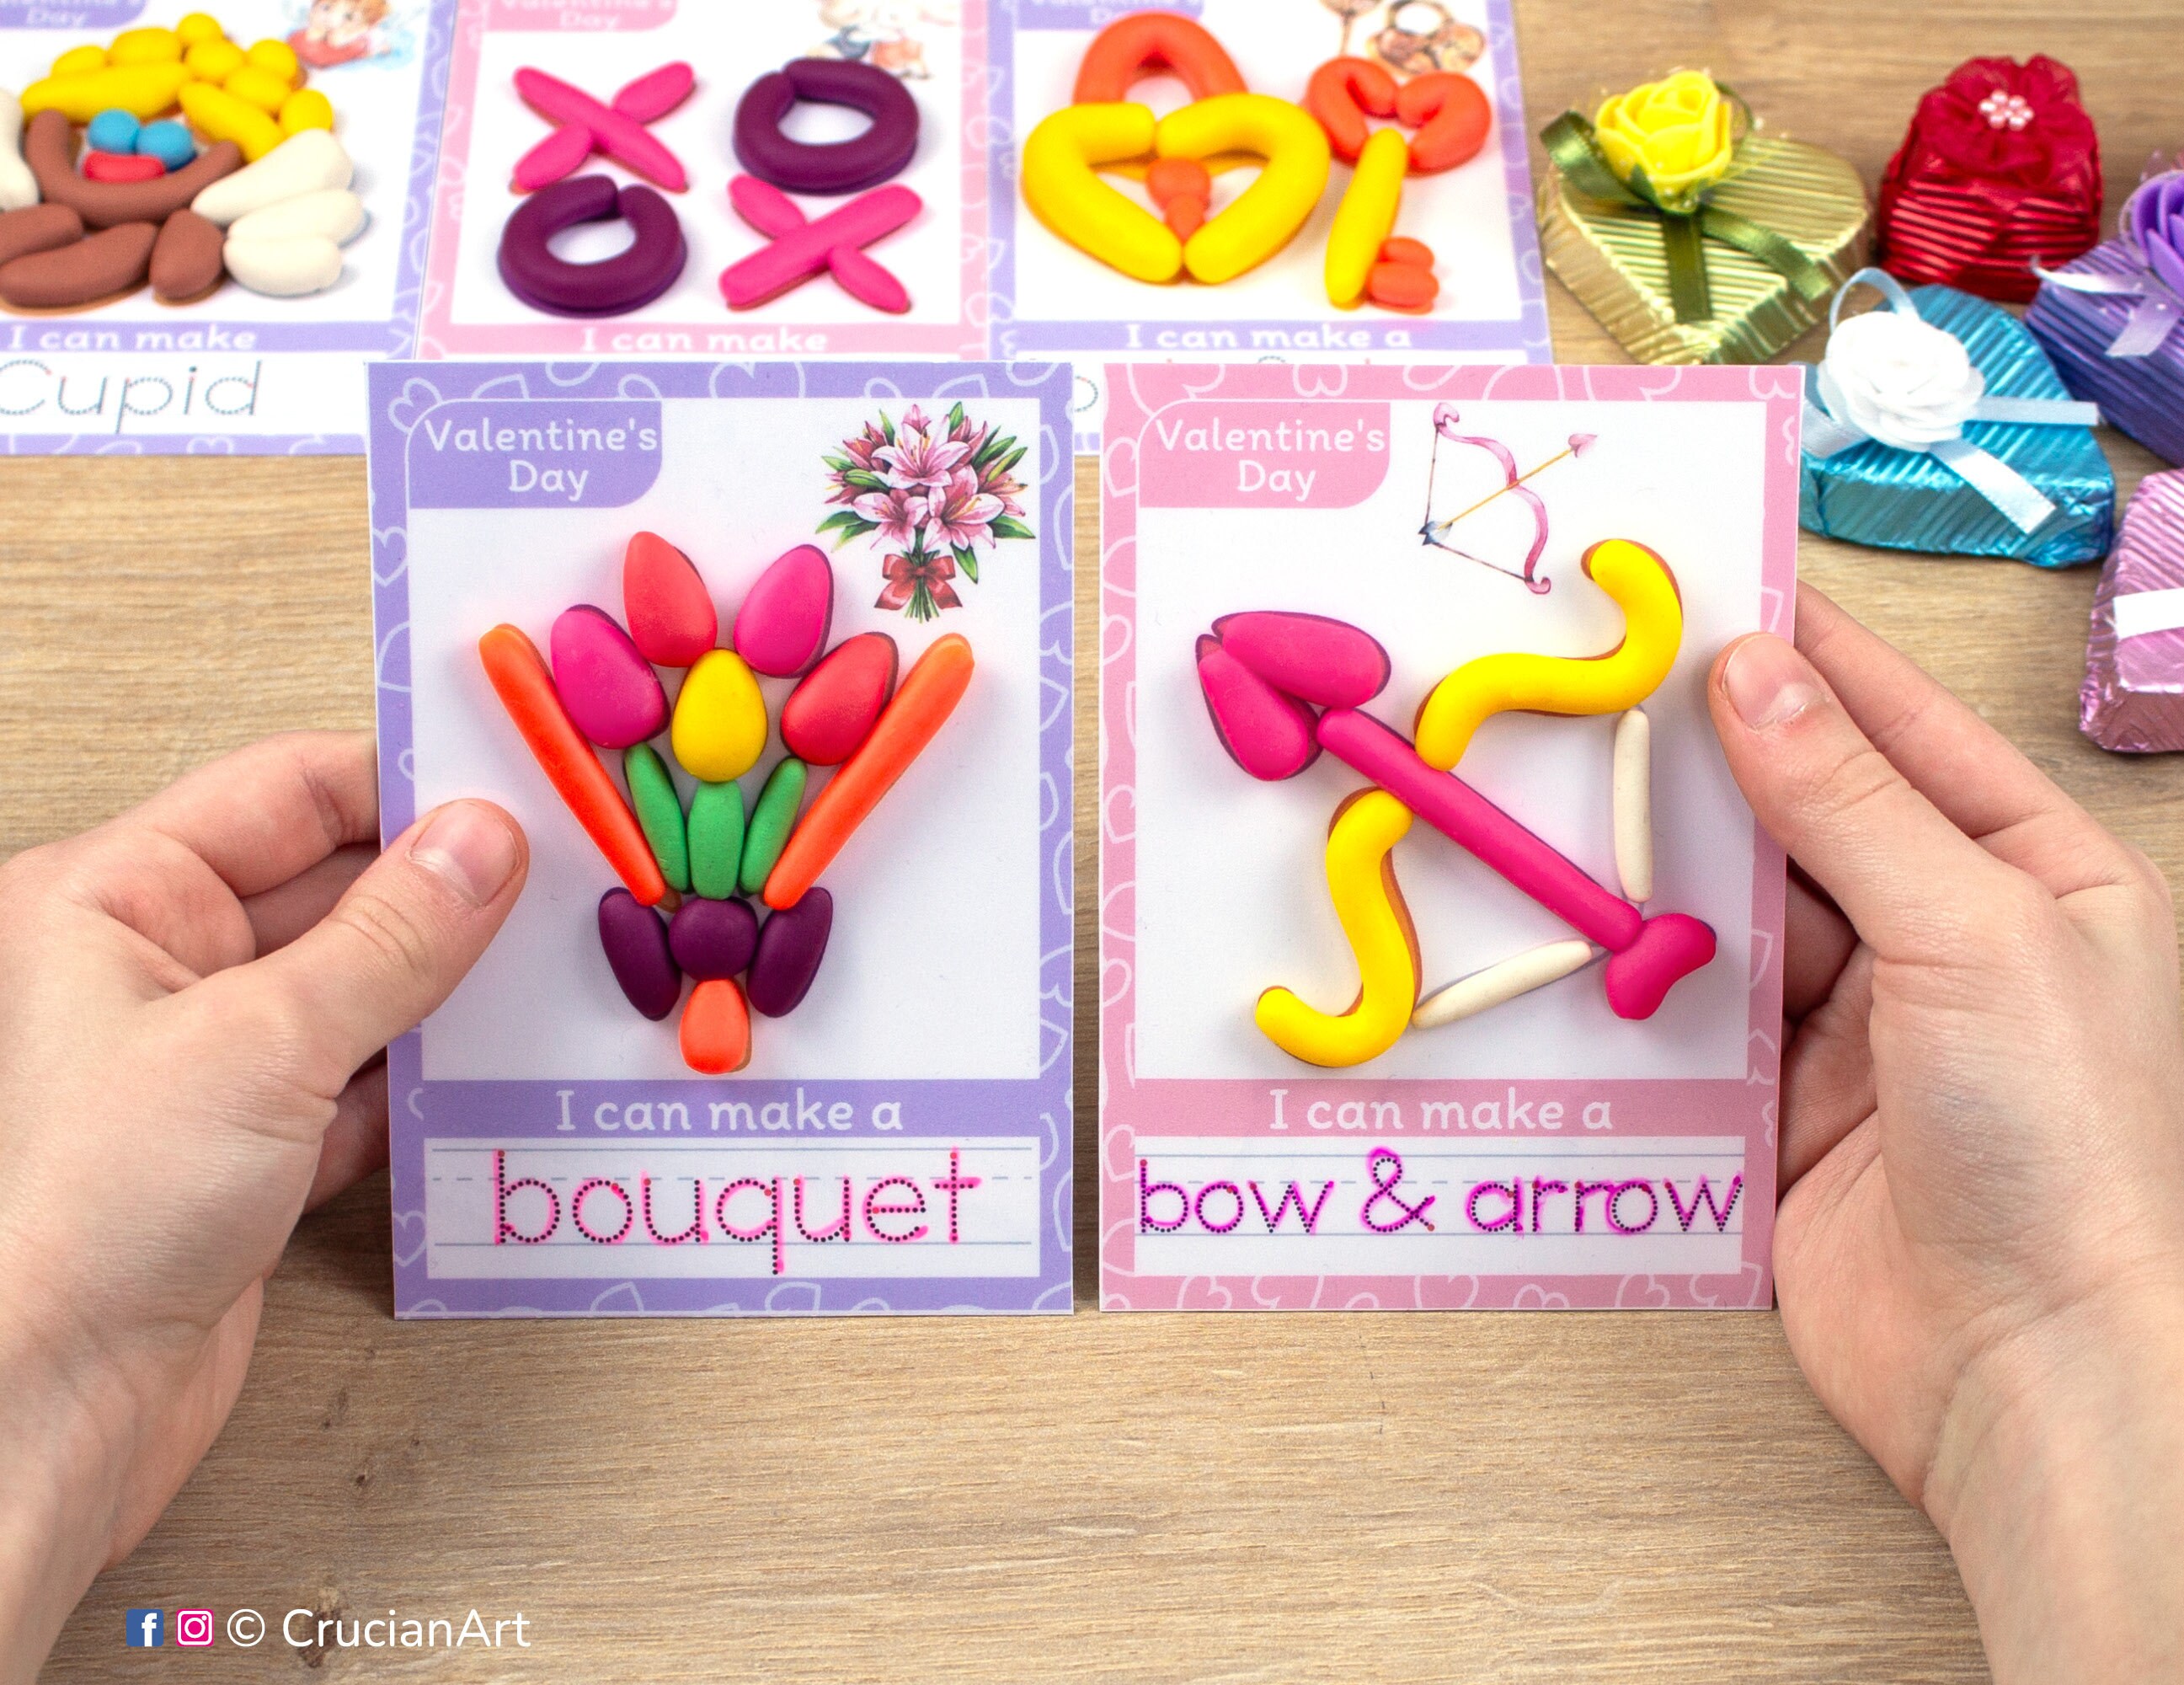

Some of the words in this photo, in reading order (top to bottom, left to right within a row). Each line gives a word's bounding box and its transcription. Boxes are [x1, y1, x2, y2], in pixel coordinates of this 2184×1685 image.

[8, 324, 26, 350] I
[39, 329, 120, 350] can
[135, 323, 257, 350] make
[579, 326, 597, 352] I
[611, 331, 693, 351] can
[708, 325, 828, 351] make
[1125, 324, 1143, 348] I
[1156, 329, 1237, 349] can
[1252, 323, 1372, 349] make
[1384, 329, 1412, 349] a
[0, 359, 263, 434] Cupid
[424, 416, 658, 452] Valentine's
[1155, 416, 1386, 452] Valentine's
[508, 458, 589, 502] Day
[1236, 458, 1316, 502] Day
[555, 1089, 577, 1131] I
[594, 1101, 692, 1131] can
[708, 1087, 854, 1131] make
[872, 1101, 904, 1131] a
[1268, 1089, 1289, 1130] I
[1306, 1100, 1404, 1130] can
[1421, 1086, 1565, 1130] make
[1582, 1100, 1613, 1130] a
[492, 1147, 982, 1275] bouquet
[1139, 1158, 1334, 1235] bow
[1360, 1147, 1436, 1233] &
[1466, 1172, 1743, 1237] arrow
